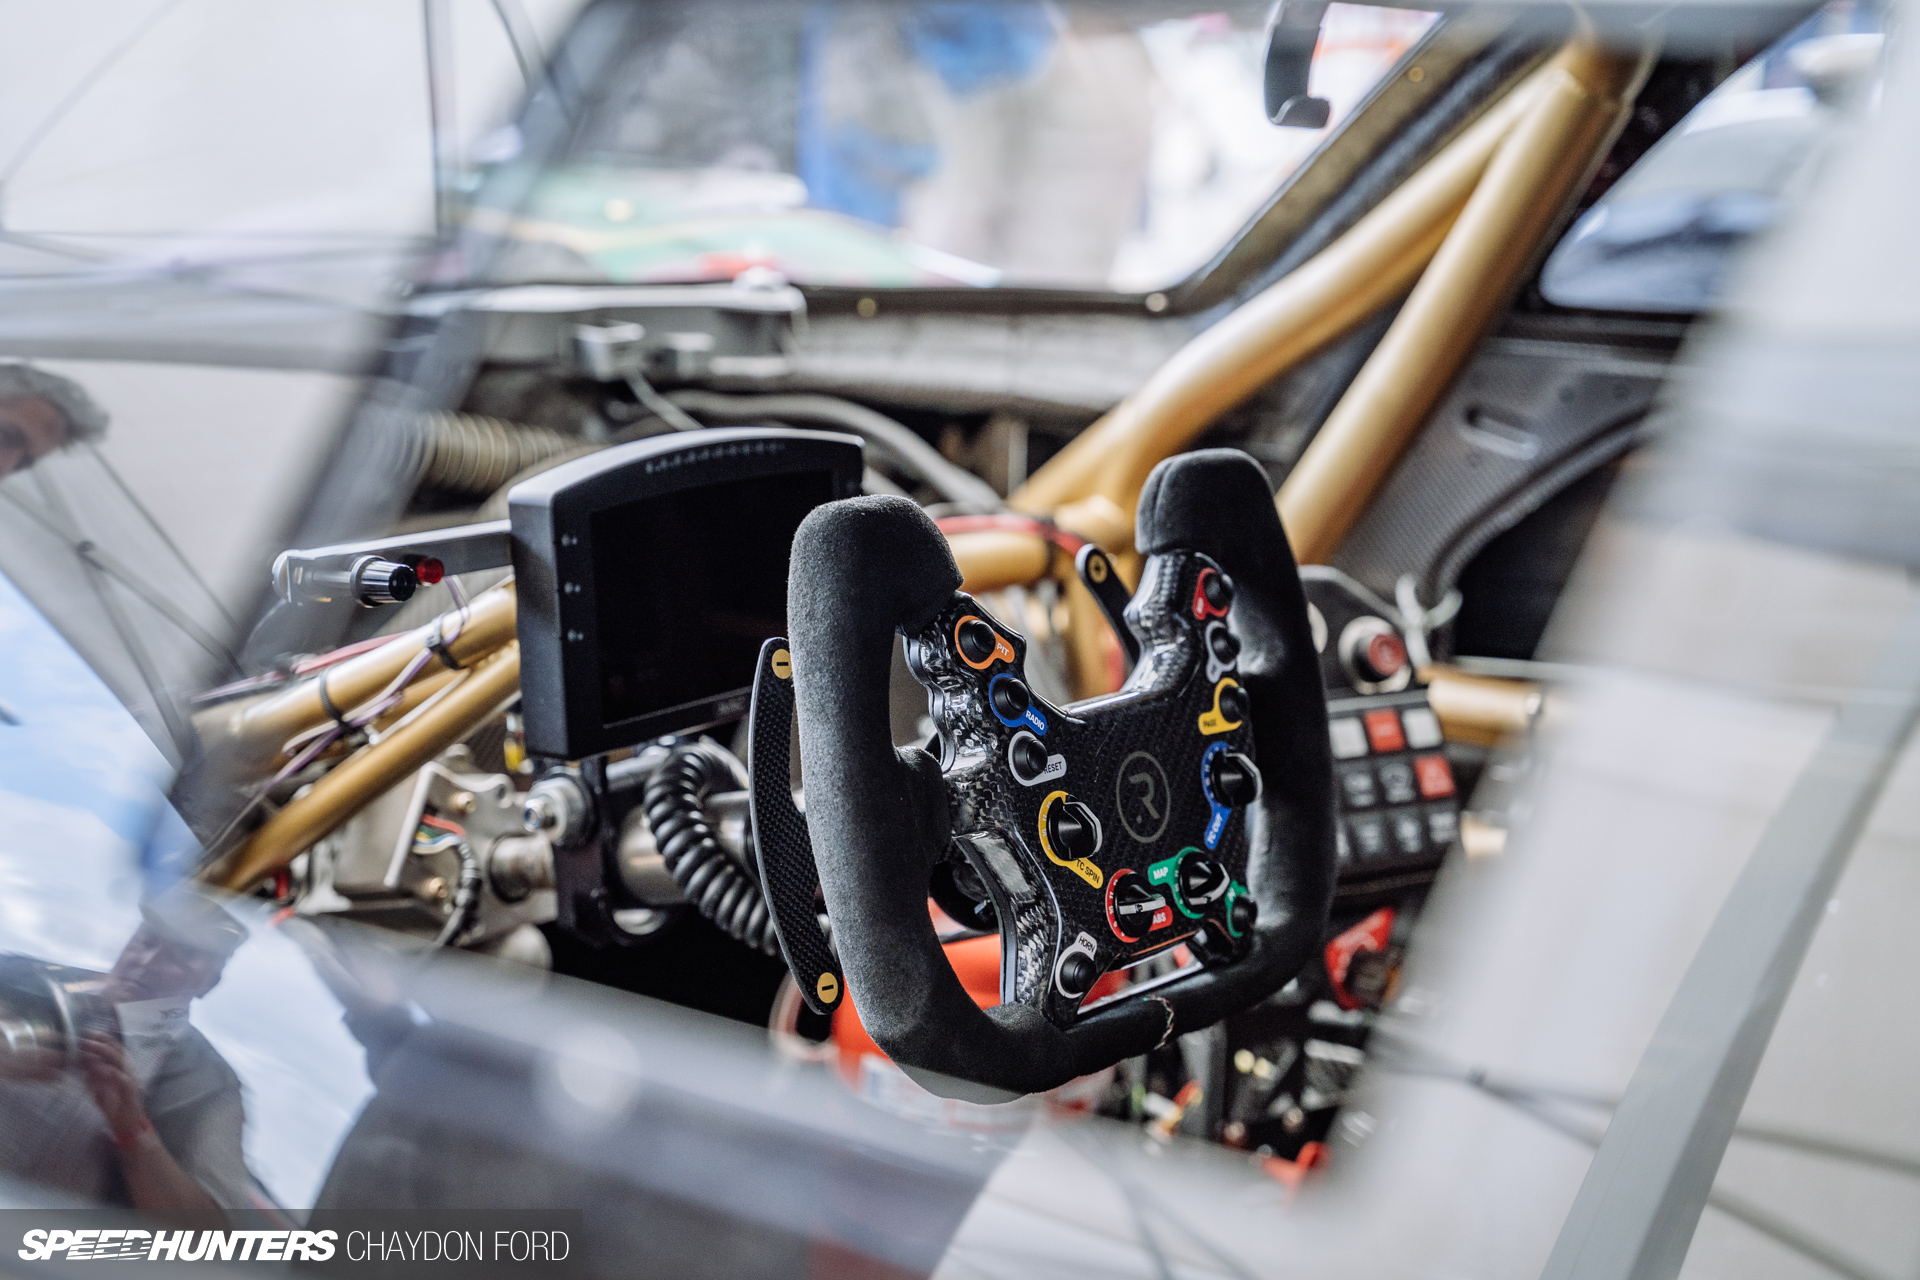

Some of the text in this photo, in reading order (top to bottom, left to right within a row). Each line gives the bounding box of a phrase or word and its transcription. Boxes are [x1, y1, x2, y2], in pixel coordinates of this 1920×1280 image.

[996, 642, 1010, 656] PIT
[1025, 710, 1045, 731] RADIO
[1077, 860, 1100, 884] TC SPIN
[1153, 866, 1169, 880] MAP
[1152, 912, 1166, 925] ABS
[1078, 936, 1096, 953] HORN
